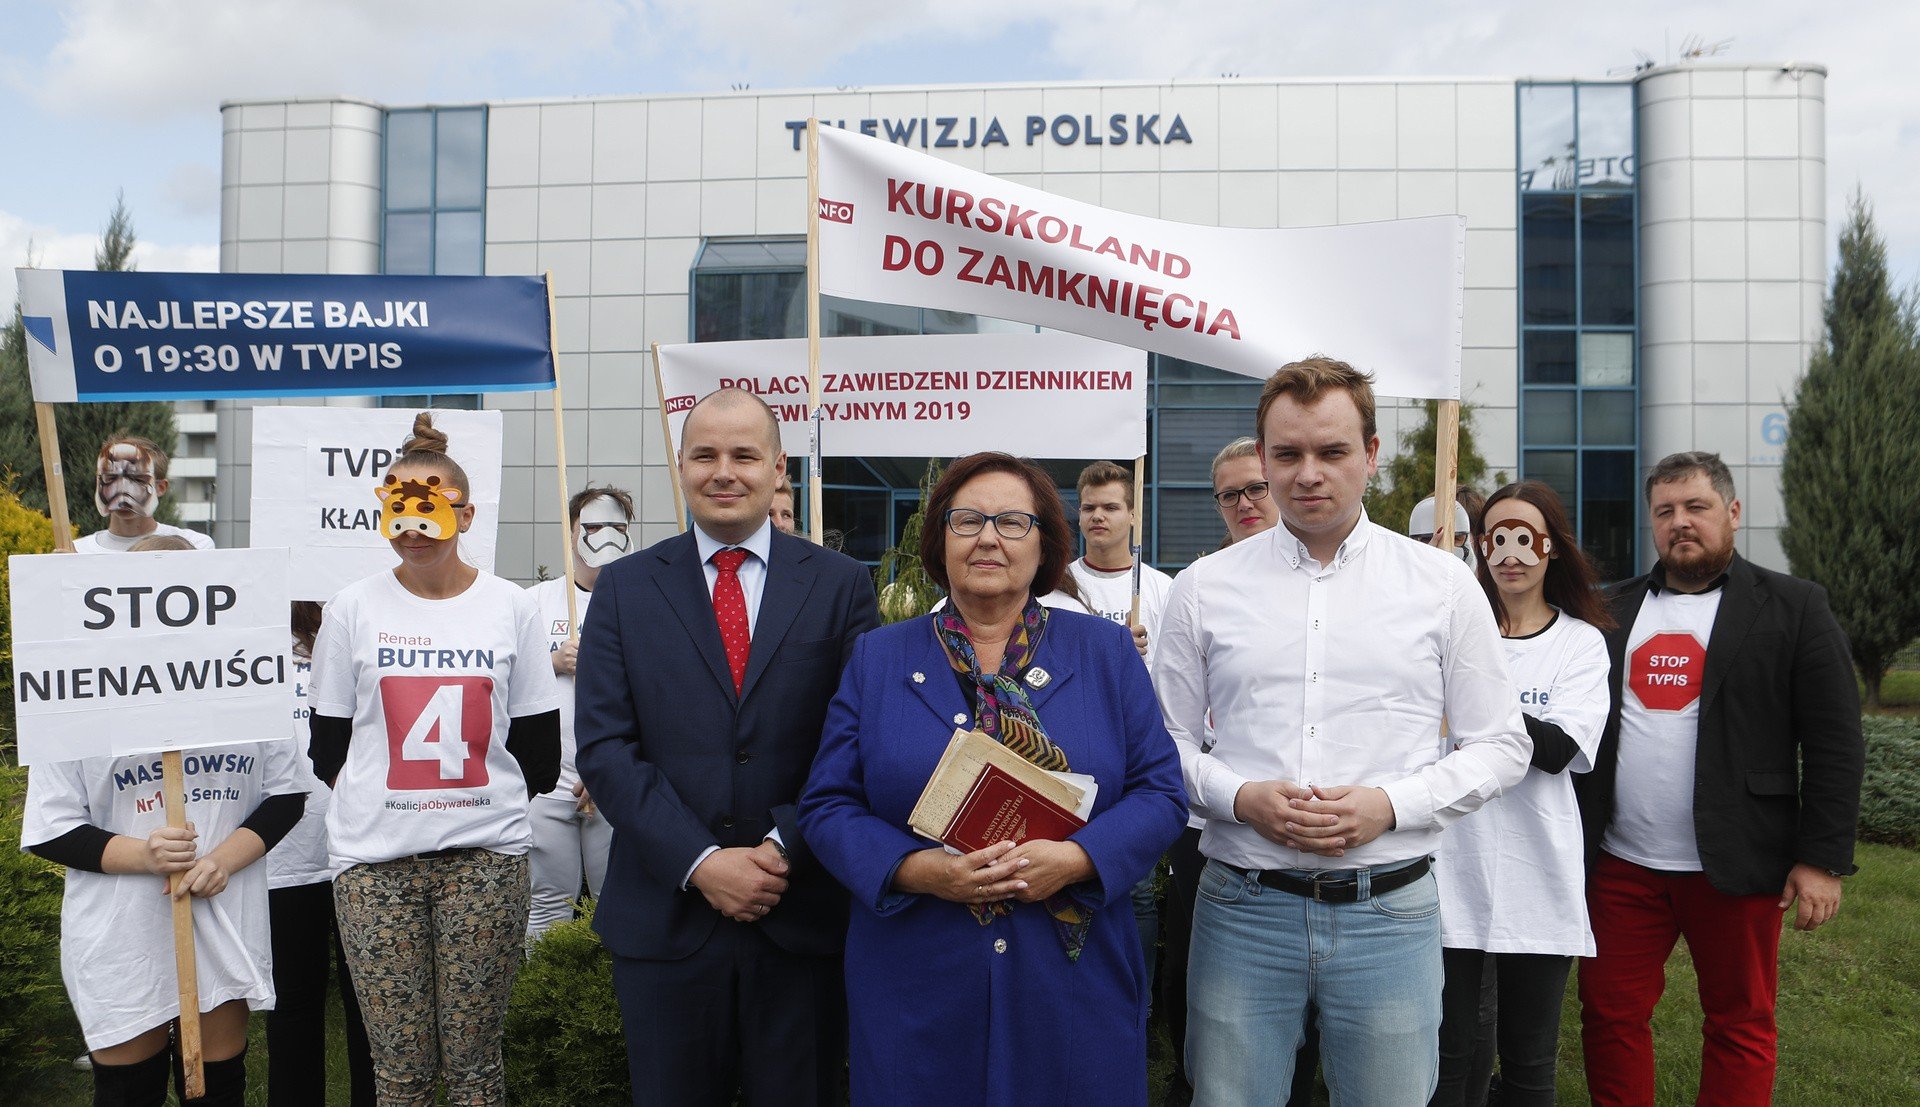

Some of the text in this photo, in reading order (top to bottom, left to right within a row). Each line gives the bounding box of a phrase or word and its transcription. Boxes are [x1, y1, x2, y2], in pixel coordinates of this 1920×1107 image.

[785, 114, 1192, 150] TEWIZJA POLSKA
[887, 178, 1192, 279] KURSKOLAND
[882, 234, 1242, 341] DO ZAMKNIĘCIA
[88, 300, 429, 329] NAJLEPSZE BAJKI
[94, 342, 403, 373] O 19:30 W TVPIS
[822, 372, 968, 393] ZAWIEDZENI
[976, 371, 1133, 390] DZIENNIKIEM
[666, 397, 695, 411] INFO
[914, 401, 971, 421] 2019
[320, 447, 402, 478] TVP
[83, 585, 237, 630] STOP
[378, 632, 432, 646] Renata
[378, 647, 494, 669] BUTRYN
[1650, 655, 1690, 668] STOP
[1646, 673, 1688, 686] TVPIS
[402, 685, 470, 780] 4
[114, 753, 255, 792] MASOWSKI
[385, 797, 491, 812] #KoalicjaObywatelska
[982, 799, 1013, 841] KONSTYTUCJA
